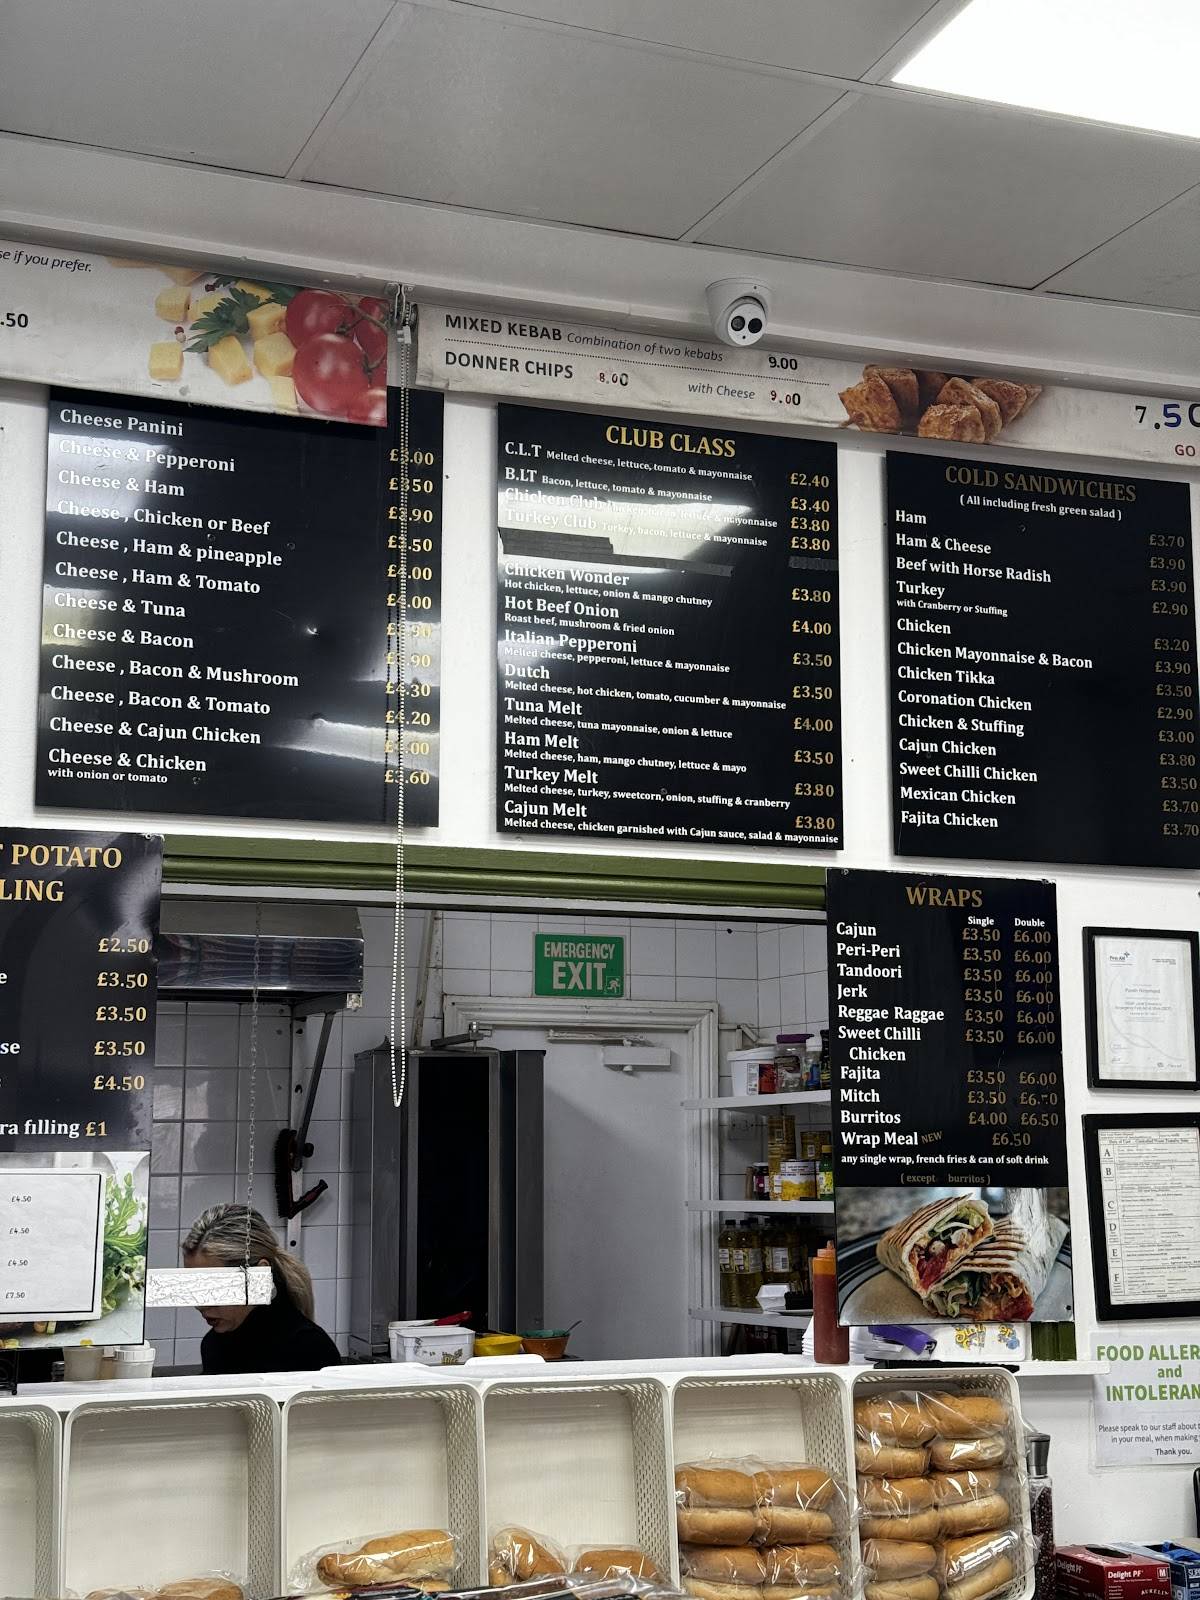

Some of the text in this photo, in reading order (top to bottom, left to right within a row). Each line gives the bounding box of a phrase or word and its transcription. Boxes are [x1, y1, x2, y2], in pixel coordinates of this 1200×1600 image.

[13, 250, 24, 264] if
[24, 254, 49, 266] you
[51, 259, 91, 272] prefer.
[446, 314, 798, 370] MIXED KEBAB Combination of two kebabs 9.00
[446, 351, 801, 406] DONNER CHIPS 8.00 with Cheese 9.00
[60, 409, 183, 436] Cheese Panini
[606, 425, 735, 457] CLUB CLASS
[59, 440, 235, 472] Cheese & Pepperoni
[1175, 444, 1196, 457] GO
[505, 442, 752, 480] C.L.T Melted cheese, lettuce, tomato & mayonnaise
[59, 470, 184, 496] Cheese & Ham
[790, 473, 829, 488] £2.40
[946, 466, 1136, 502] COLD SANDWICHES
[896, 510, 926, 524] Ham
[896, 533, 991, 554] Ham & Cheese
[1149, 534, 1185, 548] £3.70
[504, 562, 630, 586] Chicken Wonder
[896, 557, 1051, 582] Beef with Horse Radish
[792, 588, 831, 603] £3.80
[896, 580, 945, 599] Turkey
[54, 593, 185, 617] Cheese & Tuna
[505, 595, 619, 618] Hot Beef Onion
[897, 599, 916, 607] with
[918, 600, 962, 613] Cranberry
[975, 605, 1008, 617] Stuffing
[1152, 602, 1188, 615] £2.90
[792, 620, 831, 635] £4.00
[897, 618, 951, 634] Chicken
[54, 624, 193, 648] Cheese & Bacon
[504, 629, 637, 652] Italian Pepperoni
[793, 652, 832, 667] £3.50
[505, 664, 550, 679] Dutch
[898, 666, 995, 684] Chicken Tikka
[793, 685, 832, 700] £3.50
[504, 697, 582, 715] Tuna Melt
[50, 717, 260, 744] Cheese & Cajun Chicken
[505, 731, 579, 749] Ham Melt
[49, 748, 206, 771] Cheese & Chicken
[48, 768, 73, 778] with
[76, 770, 109, 780] onion
[128, 773, 168, 783] tomato
[504, 765, 598, 785] Turkey Melt
[900, 762, 1037, 782] Sweet Chilli Chicken
[795, 783, 834, 797] £3.80
[504, 800, 587, 817] Cajun Melt
[901, 810, 998, 827] Fajita Chicken
[11, 844, 122, 868] POTATO
[905, 887, 982, 907] WRAPS
[836, 922, 876, 938] Cajun
[968, 916, 1045, 927] Single Double
[962, 928, 1051, 943] £3.50 £6.00
[98, 938, 149, 953] £2.50
[544, 942, 615, 959] EMERGENCY
[837, 943, 900, 957] Peri-Peri
[553, 961, 607, 990] EXIT
[837, 963, 902, 978] Tandoori
[97, 972, 148, 989] £3.50
[837, 984, 868, 1000] Jerk
[838, 1005, 944, 1024] Reggae Raggae
[94, 1075, 144, 1091] £4.50
[841, 1110, 901, 1124] Burritos
[968, 1111, 1058, 1127] £4.00 £6.50
[24, 1119, 80, 1138] filling
[85, 1121, 107, 1136] £1
[841, 1131, 942, 1148] Wrap Meal NEW
[1097, 1344, 1200, 1361] FOOD ALLER
[1158, 1364, 1182, 1378] and
[1106, 1384, 1200, 1401] INTOLERAN
[1098, 1424, 1119, 1432] Please
[1120, 1424, 1140, 1434] speak
[1141, 1424, 1148, 1432] to
[1162, 1422, 1176, 1431] staff
[1177, 1422, 1197, 1431] about
[1118, 1436, 1133, 1445] your
[1134, 1434, 1153, 1443] meal,
[1155, 1434, 1173, 1442] when
[1174, 1433, 1198, 1443] making
[1155, 1448, 1192, 1457] Thank you.
[1108, 1571, 1132, 1580] Delight
[1159, 1569, 1166, 1577] M
